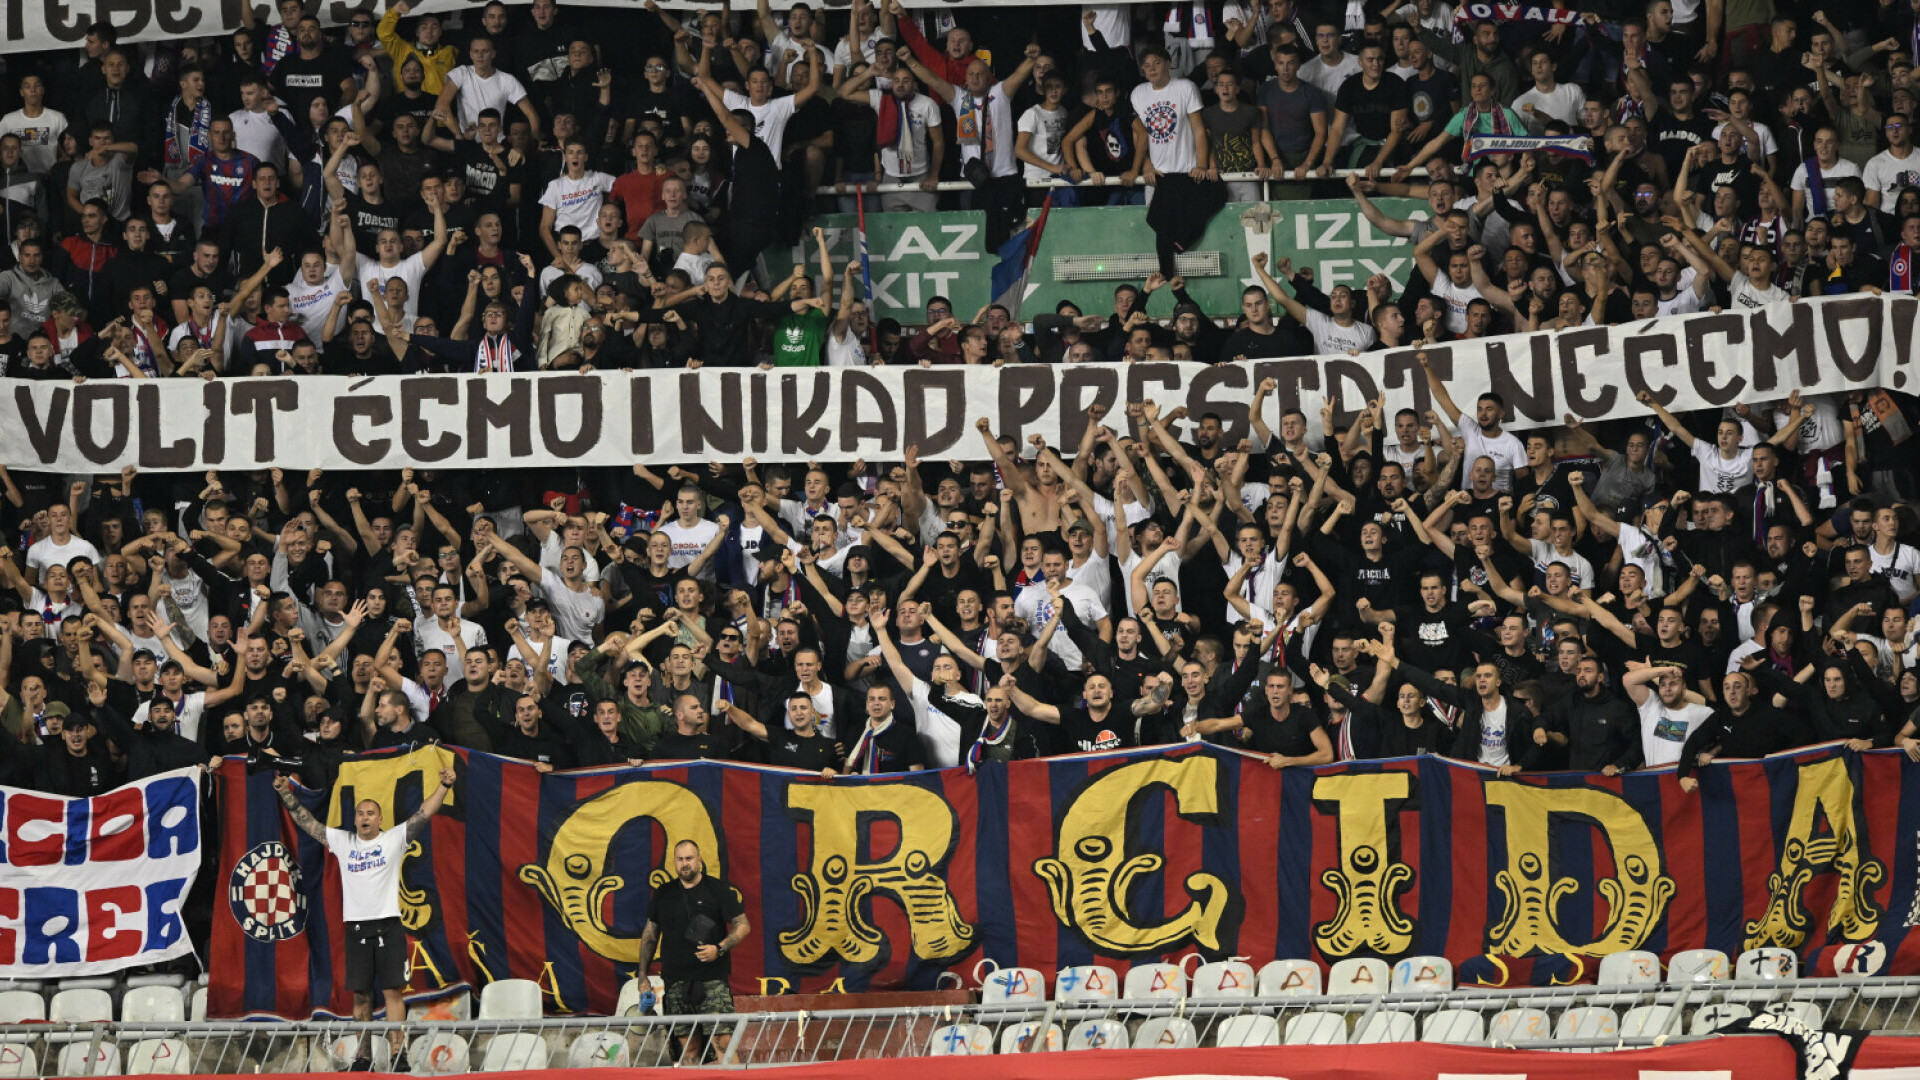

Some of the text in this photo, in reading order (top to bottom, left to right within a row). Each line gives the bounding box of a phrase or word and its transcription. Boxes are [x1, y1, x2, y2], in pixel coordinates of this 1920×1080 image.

[210, 174, 244, 187] TOMMY
[1295, 209, 1430, 250] IZLA
[782, 344, 806, 353] adidas
[14, 380, 299, 467] VOLIT
[333, 377, 603, 465] ĆEMO
[630, 376, 654, 455] I
[679, 369, 966, 458] NIKAD
[1486, 298, 1919, 422] NEĆEMO!
[0, 776, 199, 866] CIDA
[236, 843, 304, 886] HAJDUK
[327, 743, 1884, 963] TORCIDA
[242, 916, 297, 941] SPLIT
